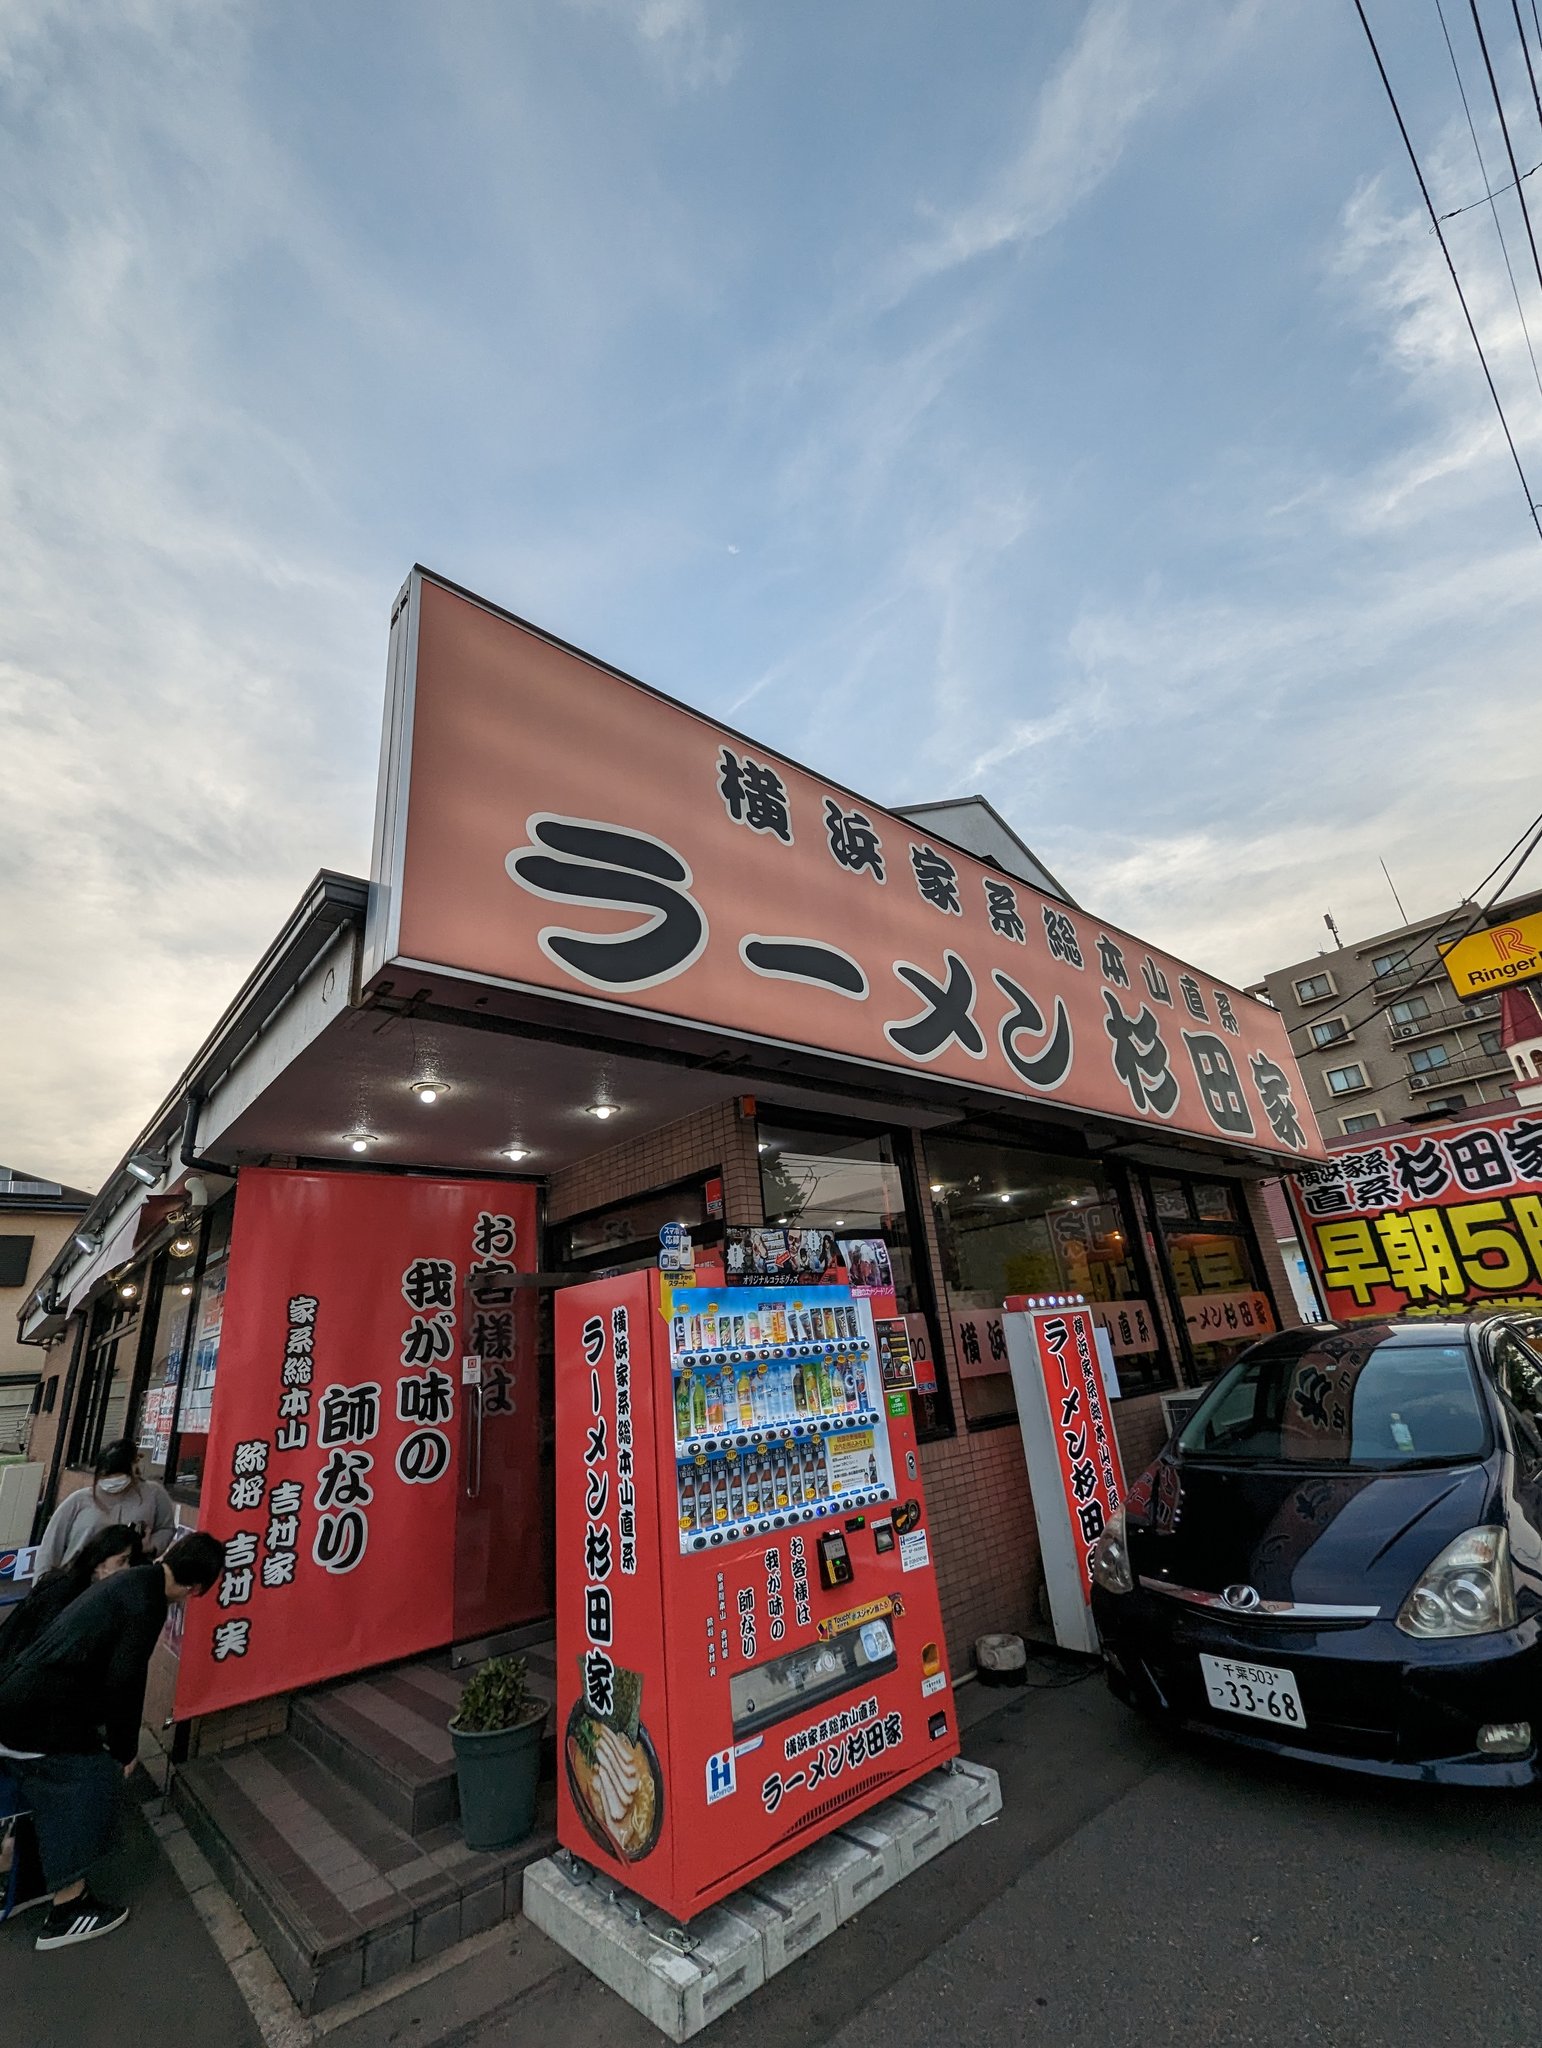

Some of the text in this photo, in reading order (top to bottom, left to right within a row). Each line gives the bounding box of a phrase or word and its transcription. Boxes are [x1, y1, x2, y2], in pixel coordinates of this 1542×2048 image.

[716, 744, 1241, 1037] 横浜家系総本山直系
[506, 811, 1308, 1151] ラーメン杉田家
[1468, 956, 1537, 986] Ringer
[1304, 1174, 1400, 1216] 直系
[261, 1295, 319, 1589] 家系総本山 吉村家
[396, 1258, 456, 1484] 我が味の
[611, 1306, 637, 1574] 横浜家系総本山直系
[313, 1382, 381, 1574] 師なり
[582, 1315, 614, 1715] ラーメン杉田家
[213, 1441, 270, 1662] 統将 吉村 実
[738, 1587, 756, 1659] 師なり
[765, 1548, 785, 1640] 我が味の
[791, 1537, 811, 1626] お客様は
[762, 1712, 902, 1813] ラーメン杉田家
[785, 1696, 878, 1760] 横浜家系総本山直系
[1211, 1681, 1298, 1722] つ 33-68
